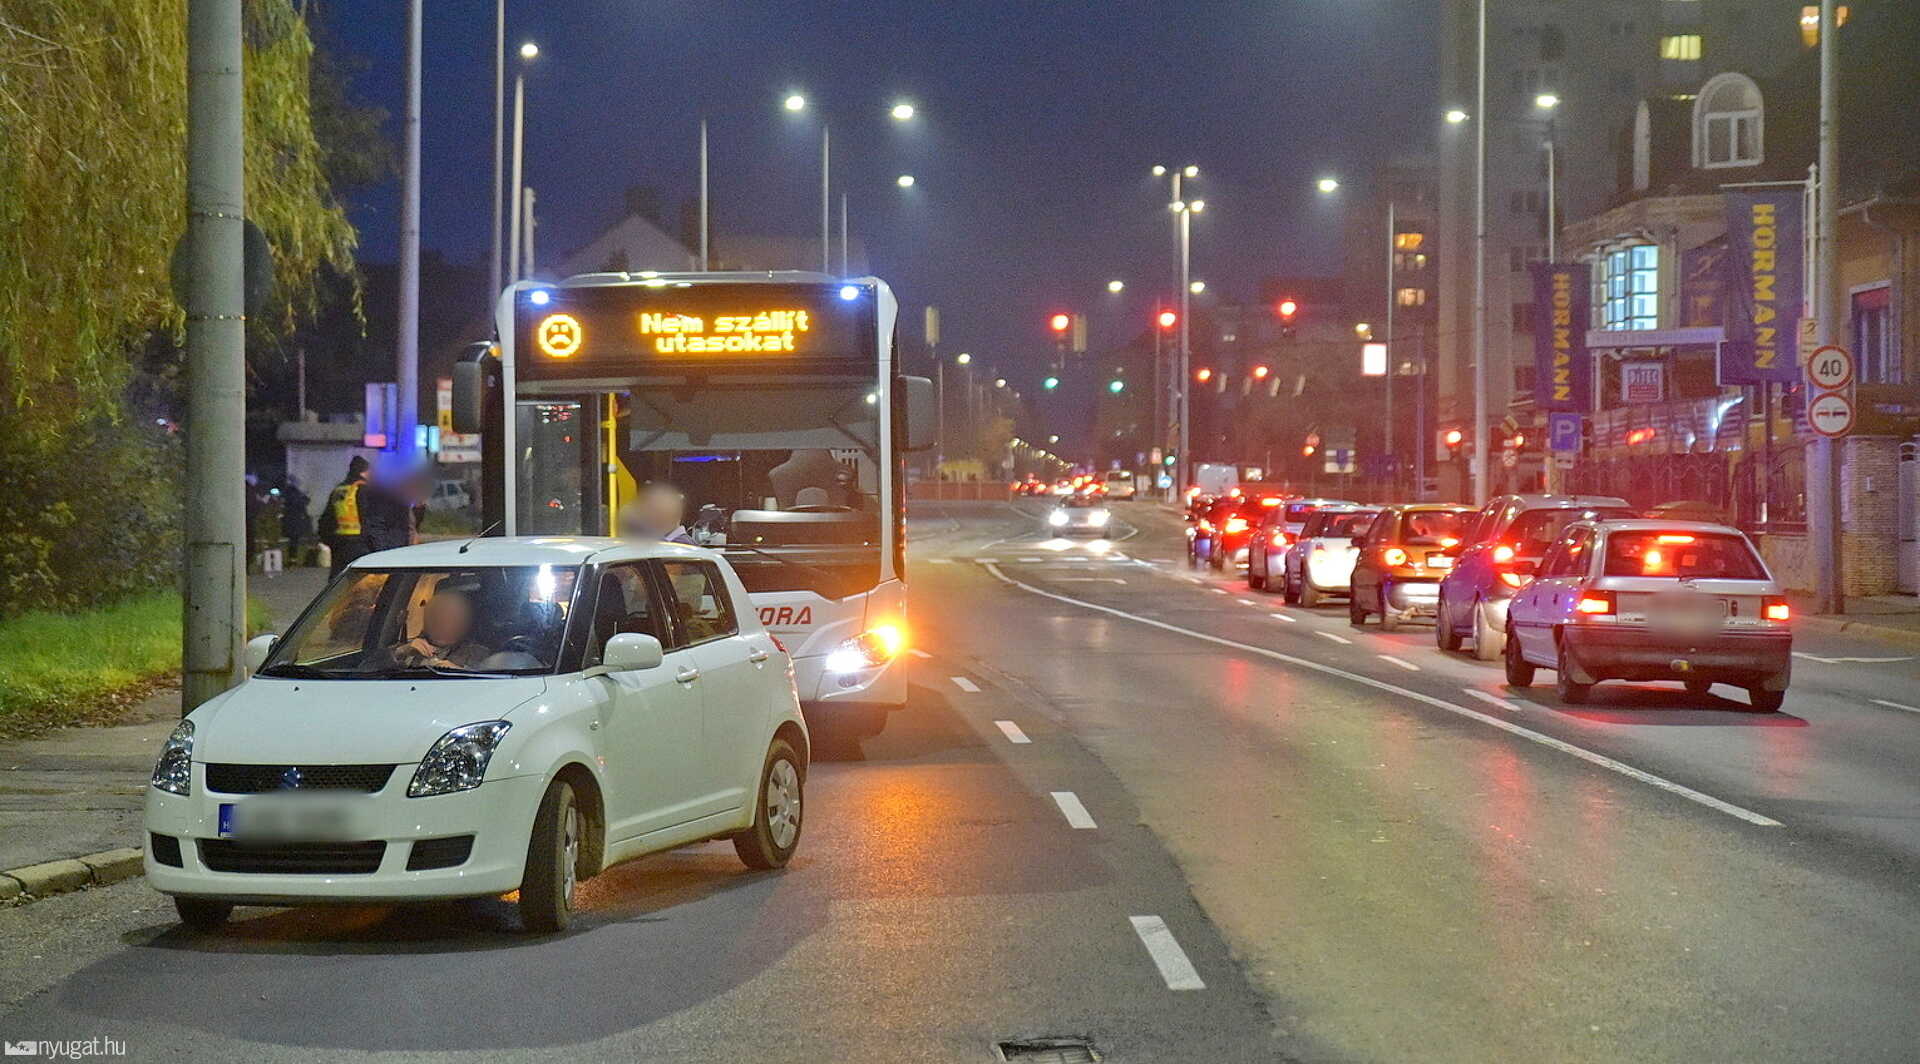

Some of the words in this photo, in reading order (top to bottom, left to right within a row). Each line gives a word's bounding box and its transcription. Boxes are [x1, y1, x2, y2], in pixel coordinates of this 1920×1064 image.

[641, 312, 703, 333] Nem
[715, 310, 808, 331] szállít
[656, 331, 794, 352] utasokat
[1819, 360, 1842, 377] 40
[1556, 420, 1575, 443] P
[755, 606, 811, 625] ORA
